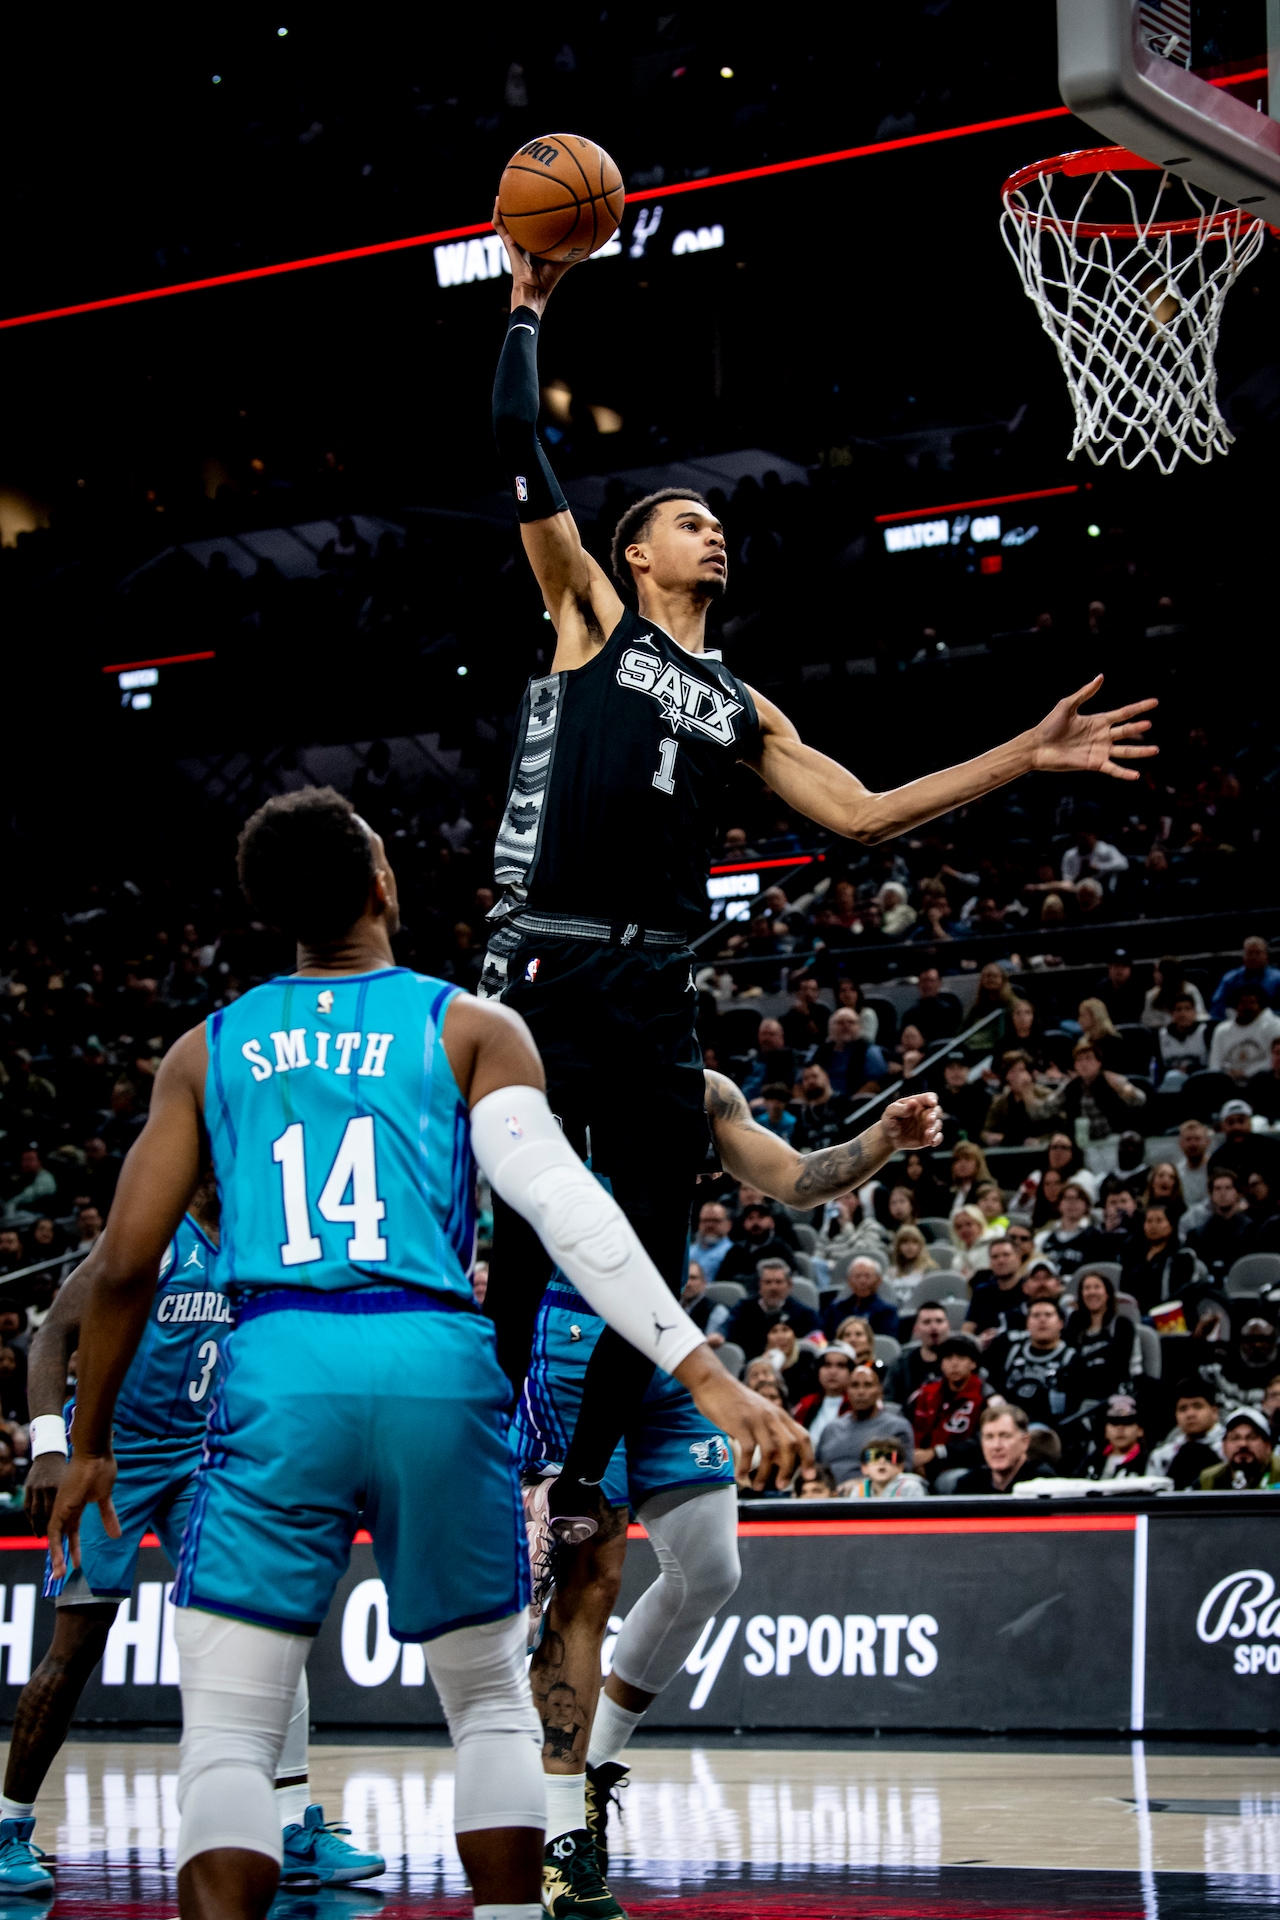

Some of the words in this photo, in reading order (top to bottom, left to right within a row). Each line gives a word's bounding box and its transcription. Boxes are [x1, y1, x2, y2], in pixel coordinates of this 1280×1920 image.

[616, 648, 745, 747] SATX
[652, 737, 679, 795] 1
[241, 1028, 394, 1082] SMITH
[272, 1115, 387, 1266] 14
[188, 1340, 218, 1403] 3
[743, 1613, 939, 1677] SPORTS
[1233, 1644, 1280, 1675] SPO
